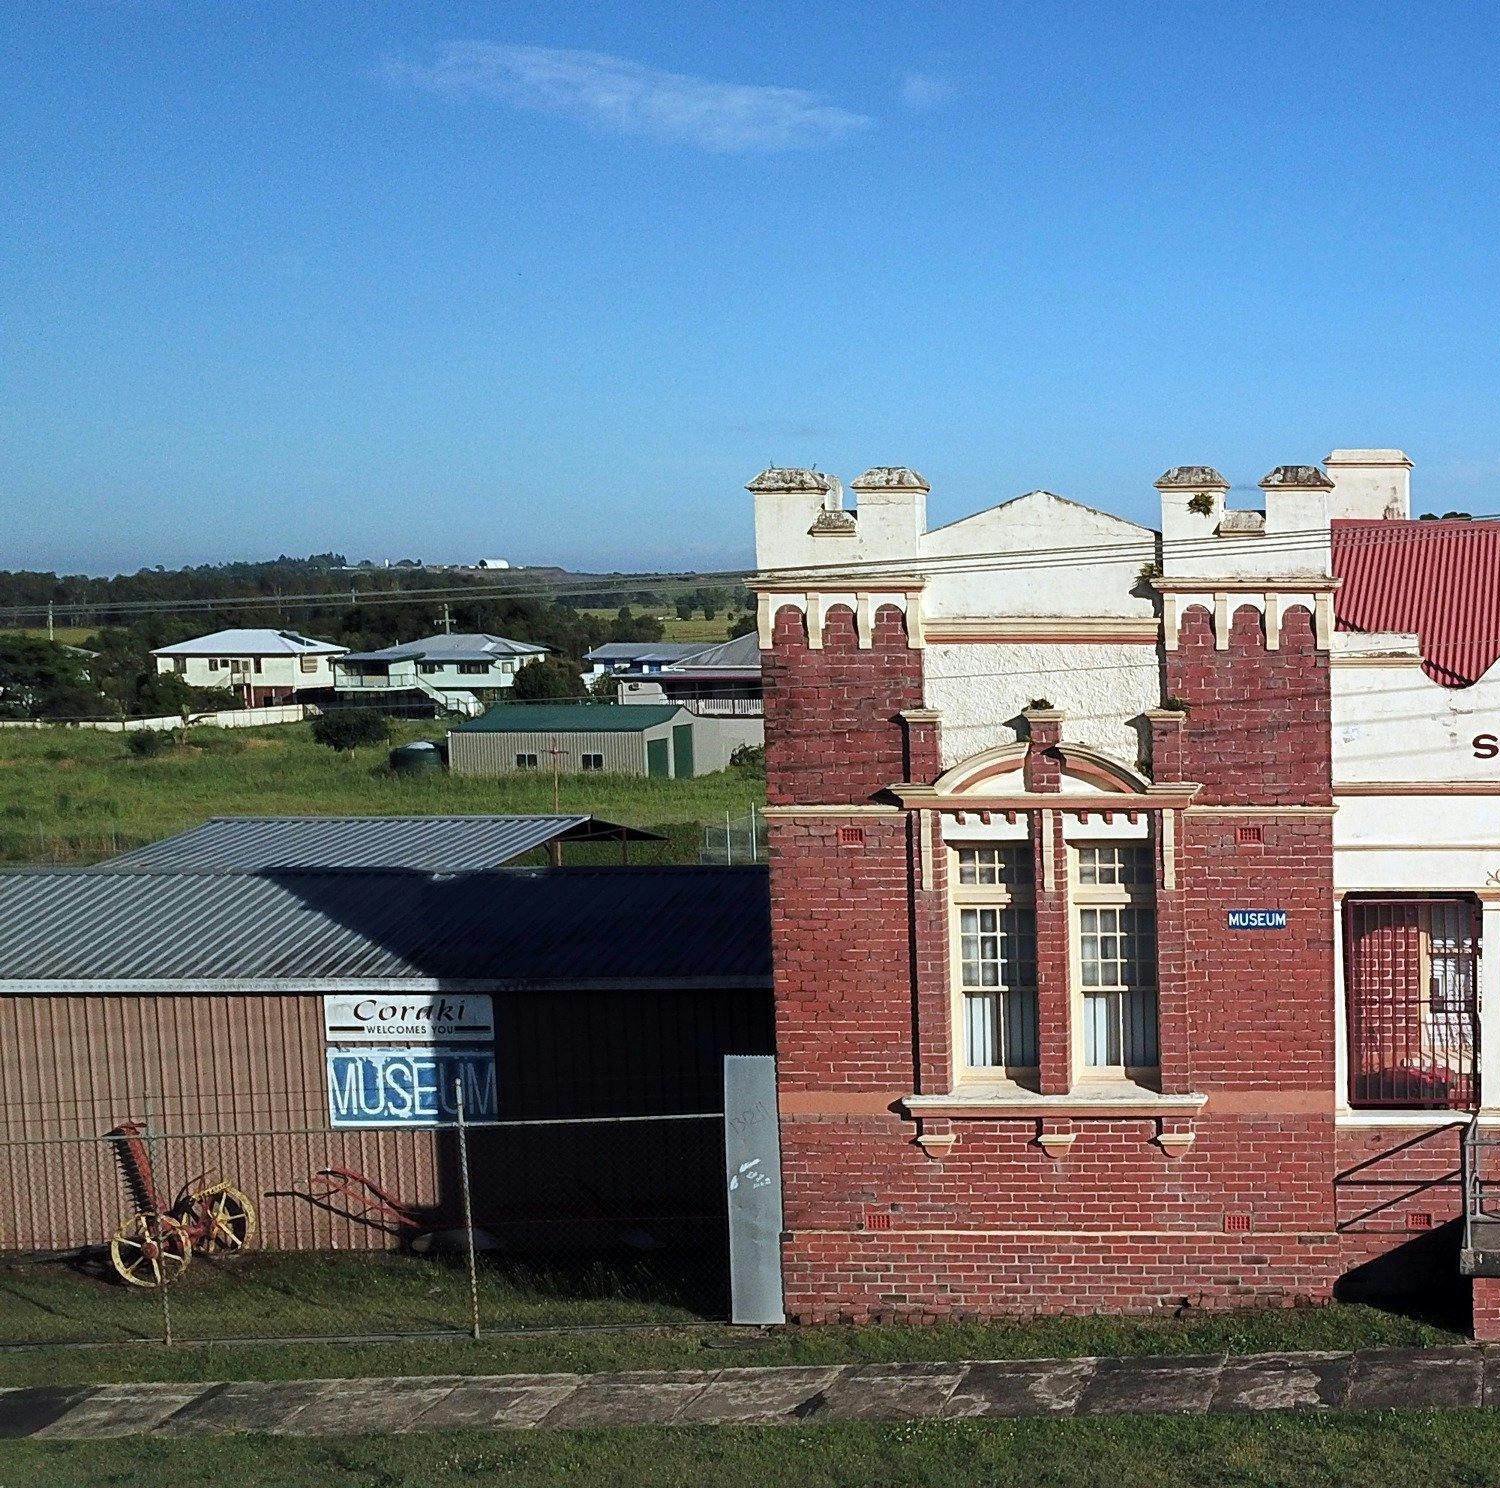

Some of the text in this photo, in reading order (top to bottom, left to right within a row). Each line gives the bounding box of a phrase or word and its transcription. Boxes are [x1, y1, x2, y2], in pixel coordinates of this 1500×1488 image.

[1228, 912, 1286, 926] MUSEUM
[353, 999, 467, 1022] Coraki
[366, 1025, 454, 1035] WELCOMES YOU
[328, 1059, 499, 1115] MUSEUM
